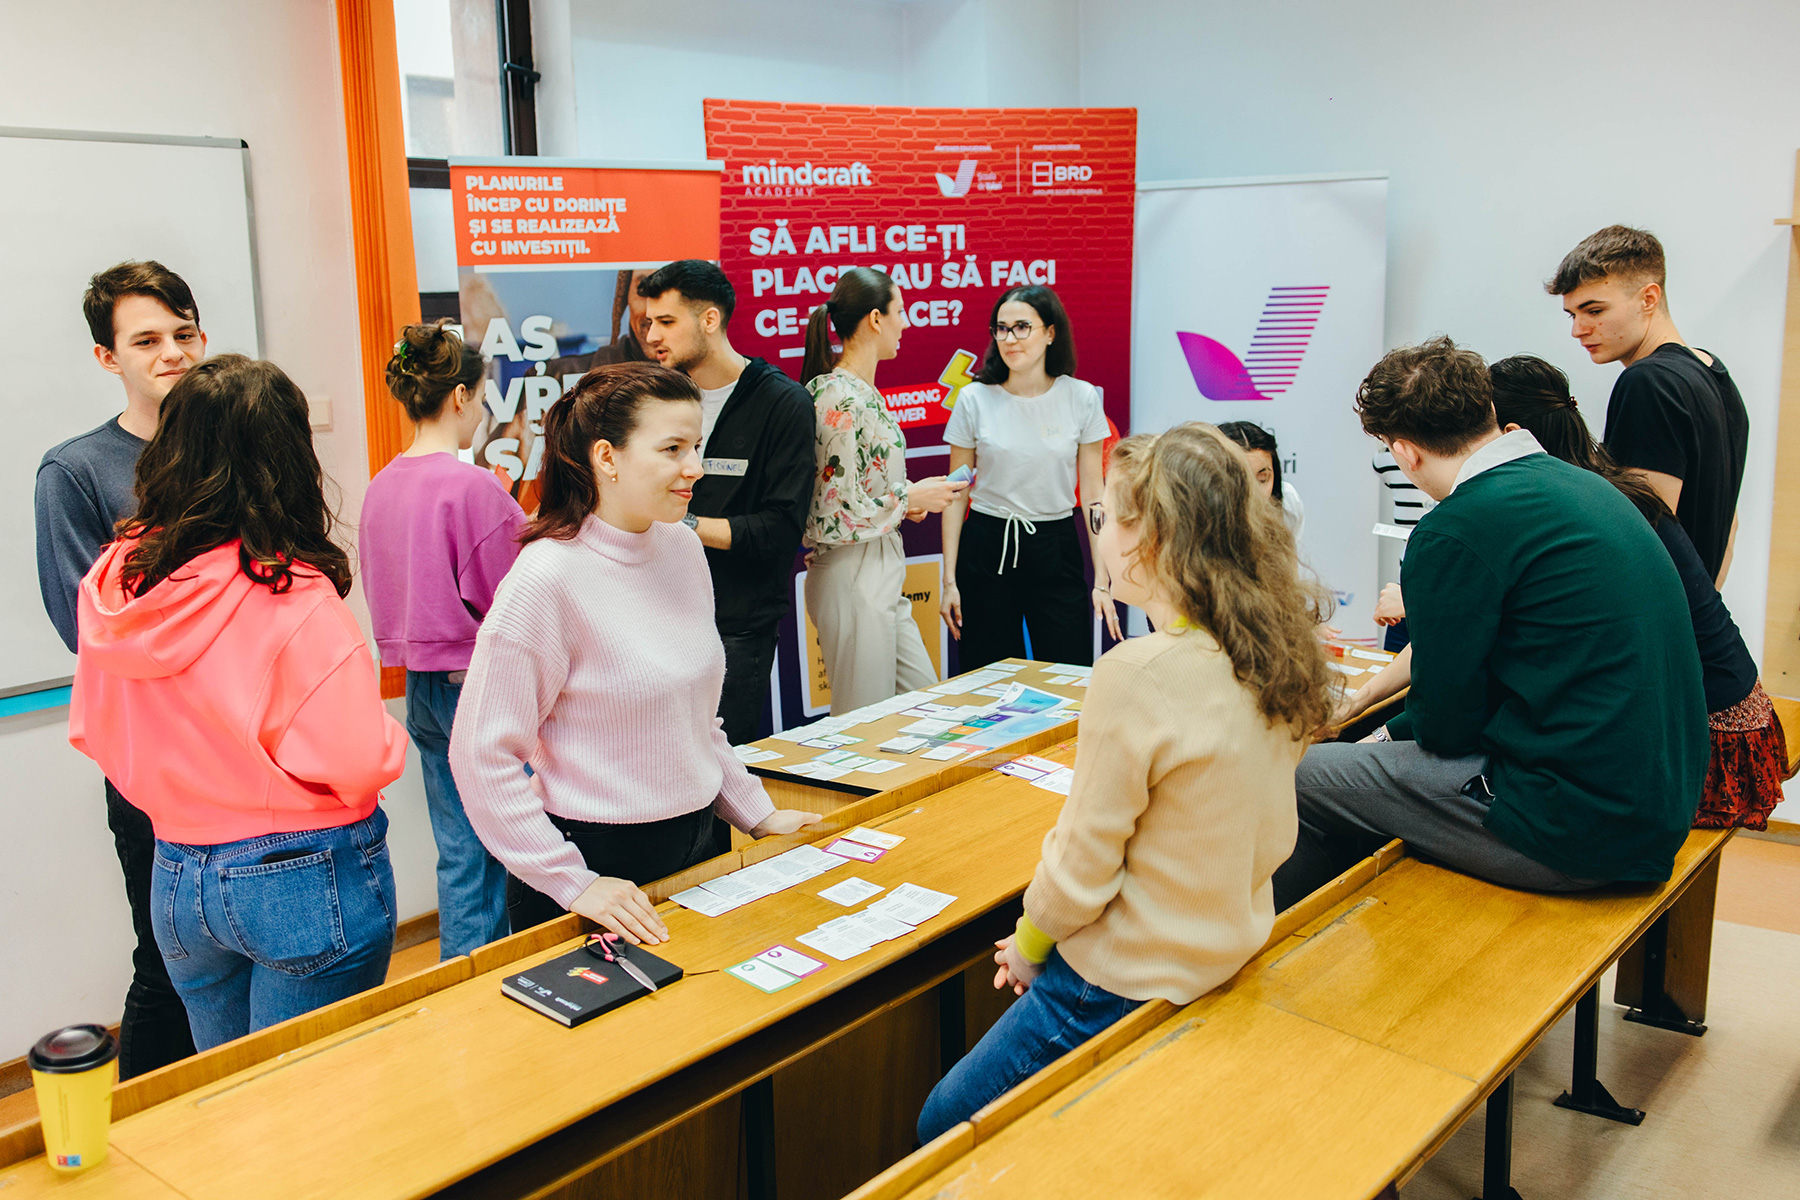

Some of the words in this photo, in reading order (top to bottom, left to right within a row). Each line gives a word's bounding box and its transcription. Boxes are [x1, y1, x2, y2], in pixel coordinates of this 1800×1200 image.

[465, 175, 564, 191] PLANURILE
[742, 158, 872, 186] mindcraft
[1055, 166, 1093, 181] BRD
[744, 187, 814, 198] ACADEMY
[466, 193, 521, 212] ÎNCEP
[525, 198, 550, 212] CU
[553, 198, 627, 217] DORINȚE
[469, 219, 486, 238] ȘI
[490, 219, 513, 234] SE
[517, 215, 620, 234] REALIZEAZĂ
[470, 240, 497, 255] CU
[501, 239, 591, 258] INVESTIȚII.
[749, 219, 797, 256] SĂ
[804, 226, 877, 254] AFLI
[884, 224, 966, 260] CE-ȚI
[752, 265, 857, 297] PLAC
[871, 263, 933, 290] AU
[940, 254, 984, 288] SĂ
[991, 259, 1056, 287] FACI
[484, 373, 588, 424] VR
[885, 388, 941, 408] WRONG
